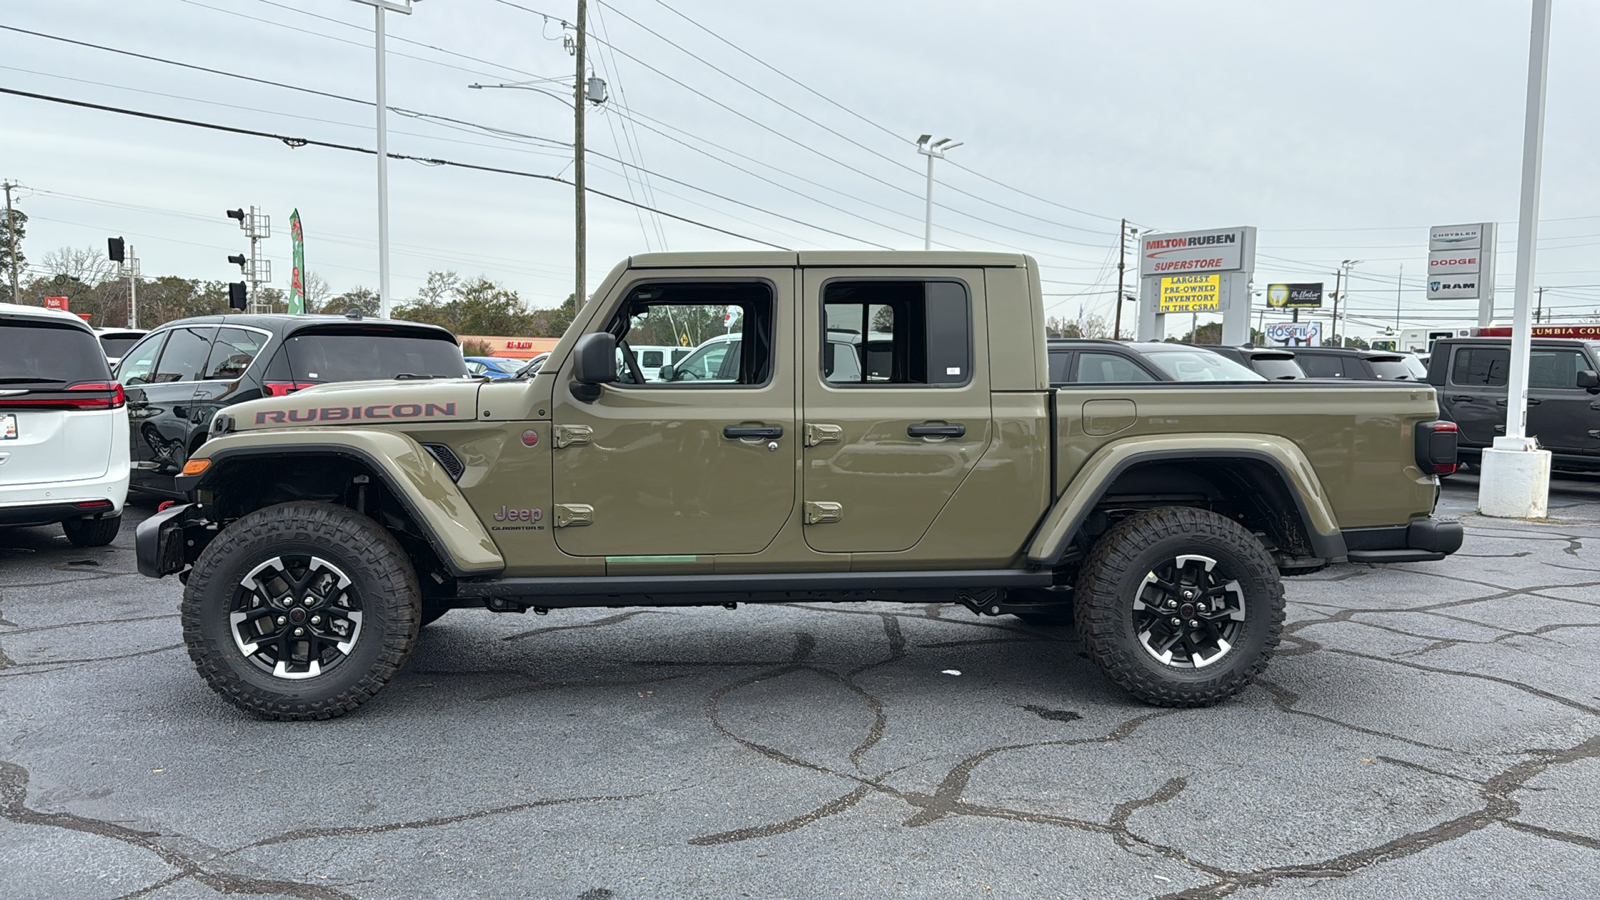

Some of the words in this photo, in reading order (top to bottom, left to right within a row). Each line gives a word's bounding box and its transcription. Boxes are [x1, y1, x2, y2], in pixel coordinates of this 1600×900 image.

[1154, 258, 1223, 271] SUPERSTORE
[1430, 258, 1477, 266] DODGE
[1171, 276, 1210, 284] LARGEST
[1164, 285, 1216, 294] PRE-OWNED
[1164, 294, 1215, 303] INVENTORY
[254, 402, 457, 425] RUBICON
[493, 505, 543, 525] Jeep
